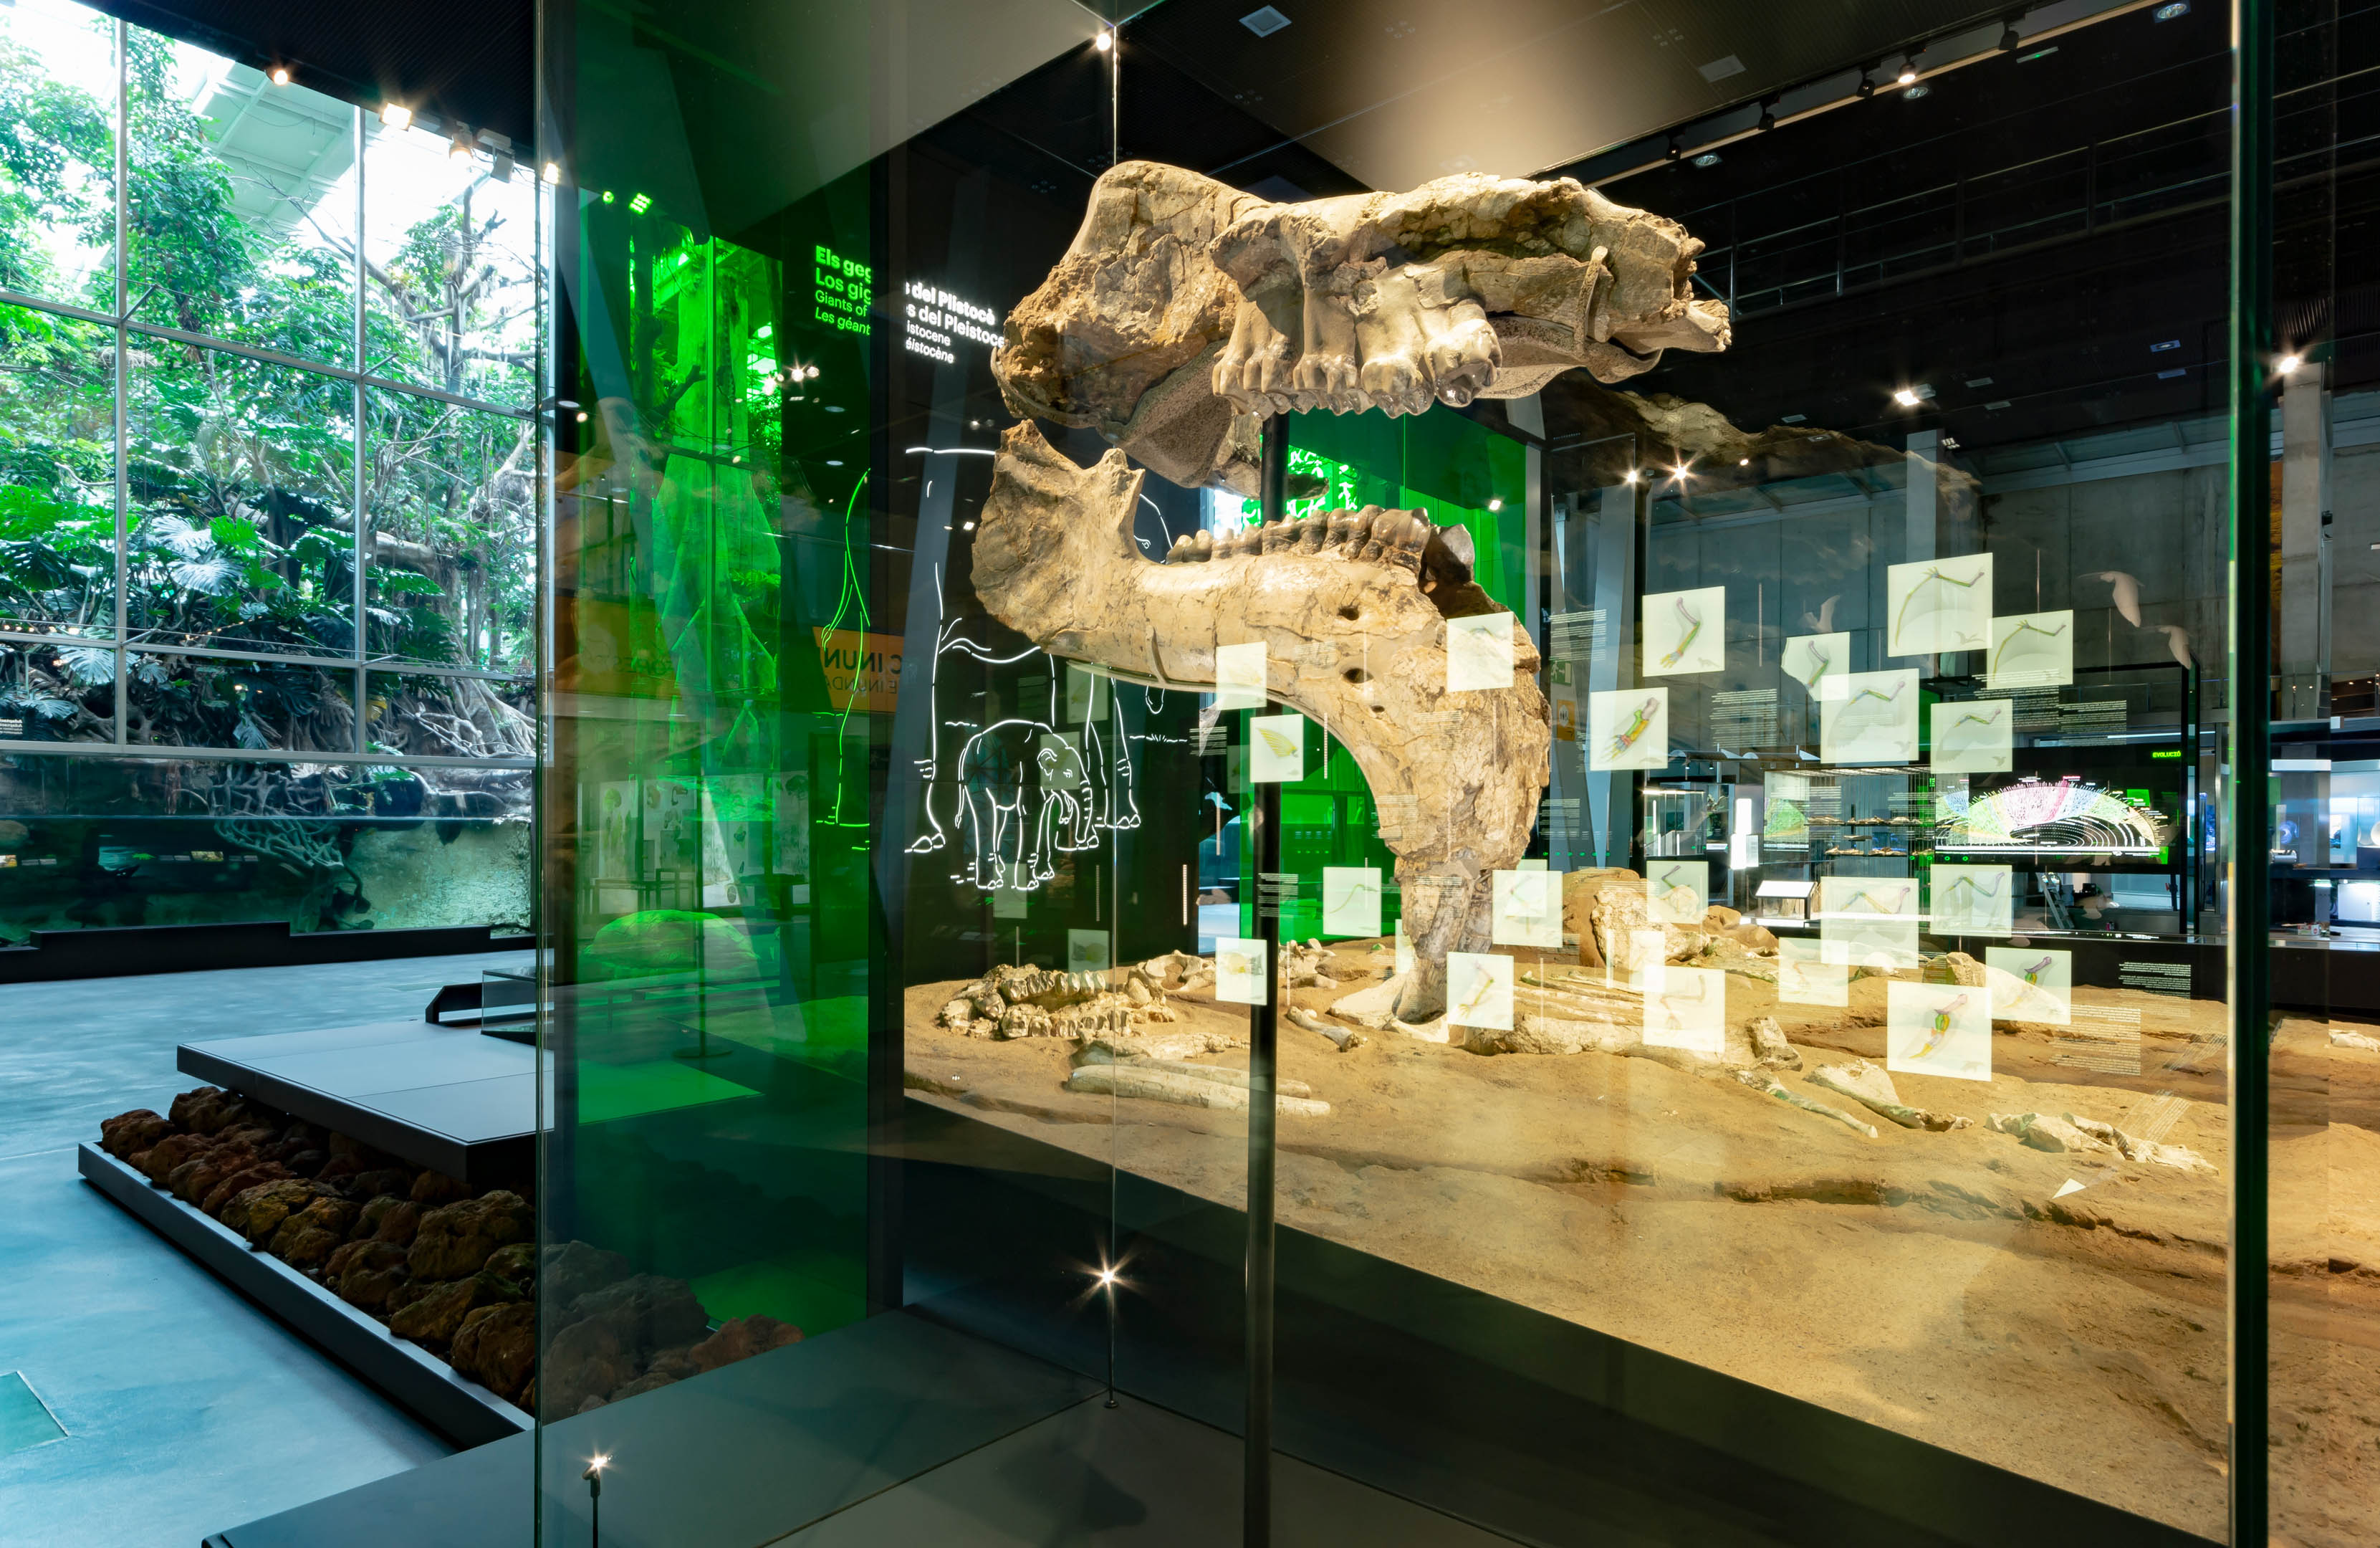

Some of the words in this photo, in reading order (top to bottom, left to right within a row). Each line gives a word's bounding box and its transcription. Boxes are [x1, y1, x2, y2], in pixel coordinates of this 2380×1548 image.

[815, 245, 840, 269] Els
[911, 282, 936, 305] del
[815, 267, 844, 292] Los
[918, 305, 941, 327] del
[944, 313, 1004, 348] Pleistoce
[815, 290, 853, 312] Giants
[855, 305, 868, 317] of
[906, 320, 951, 346] istocene
[815, 307, 835, 324] Les
[837, 316, 871, 335] géant
[906, 336, 954, 363] éistocène
